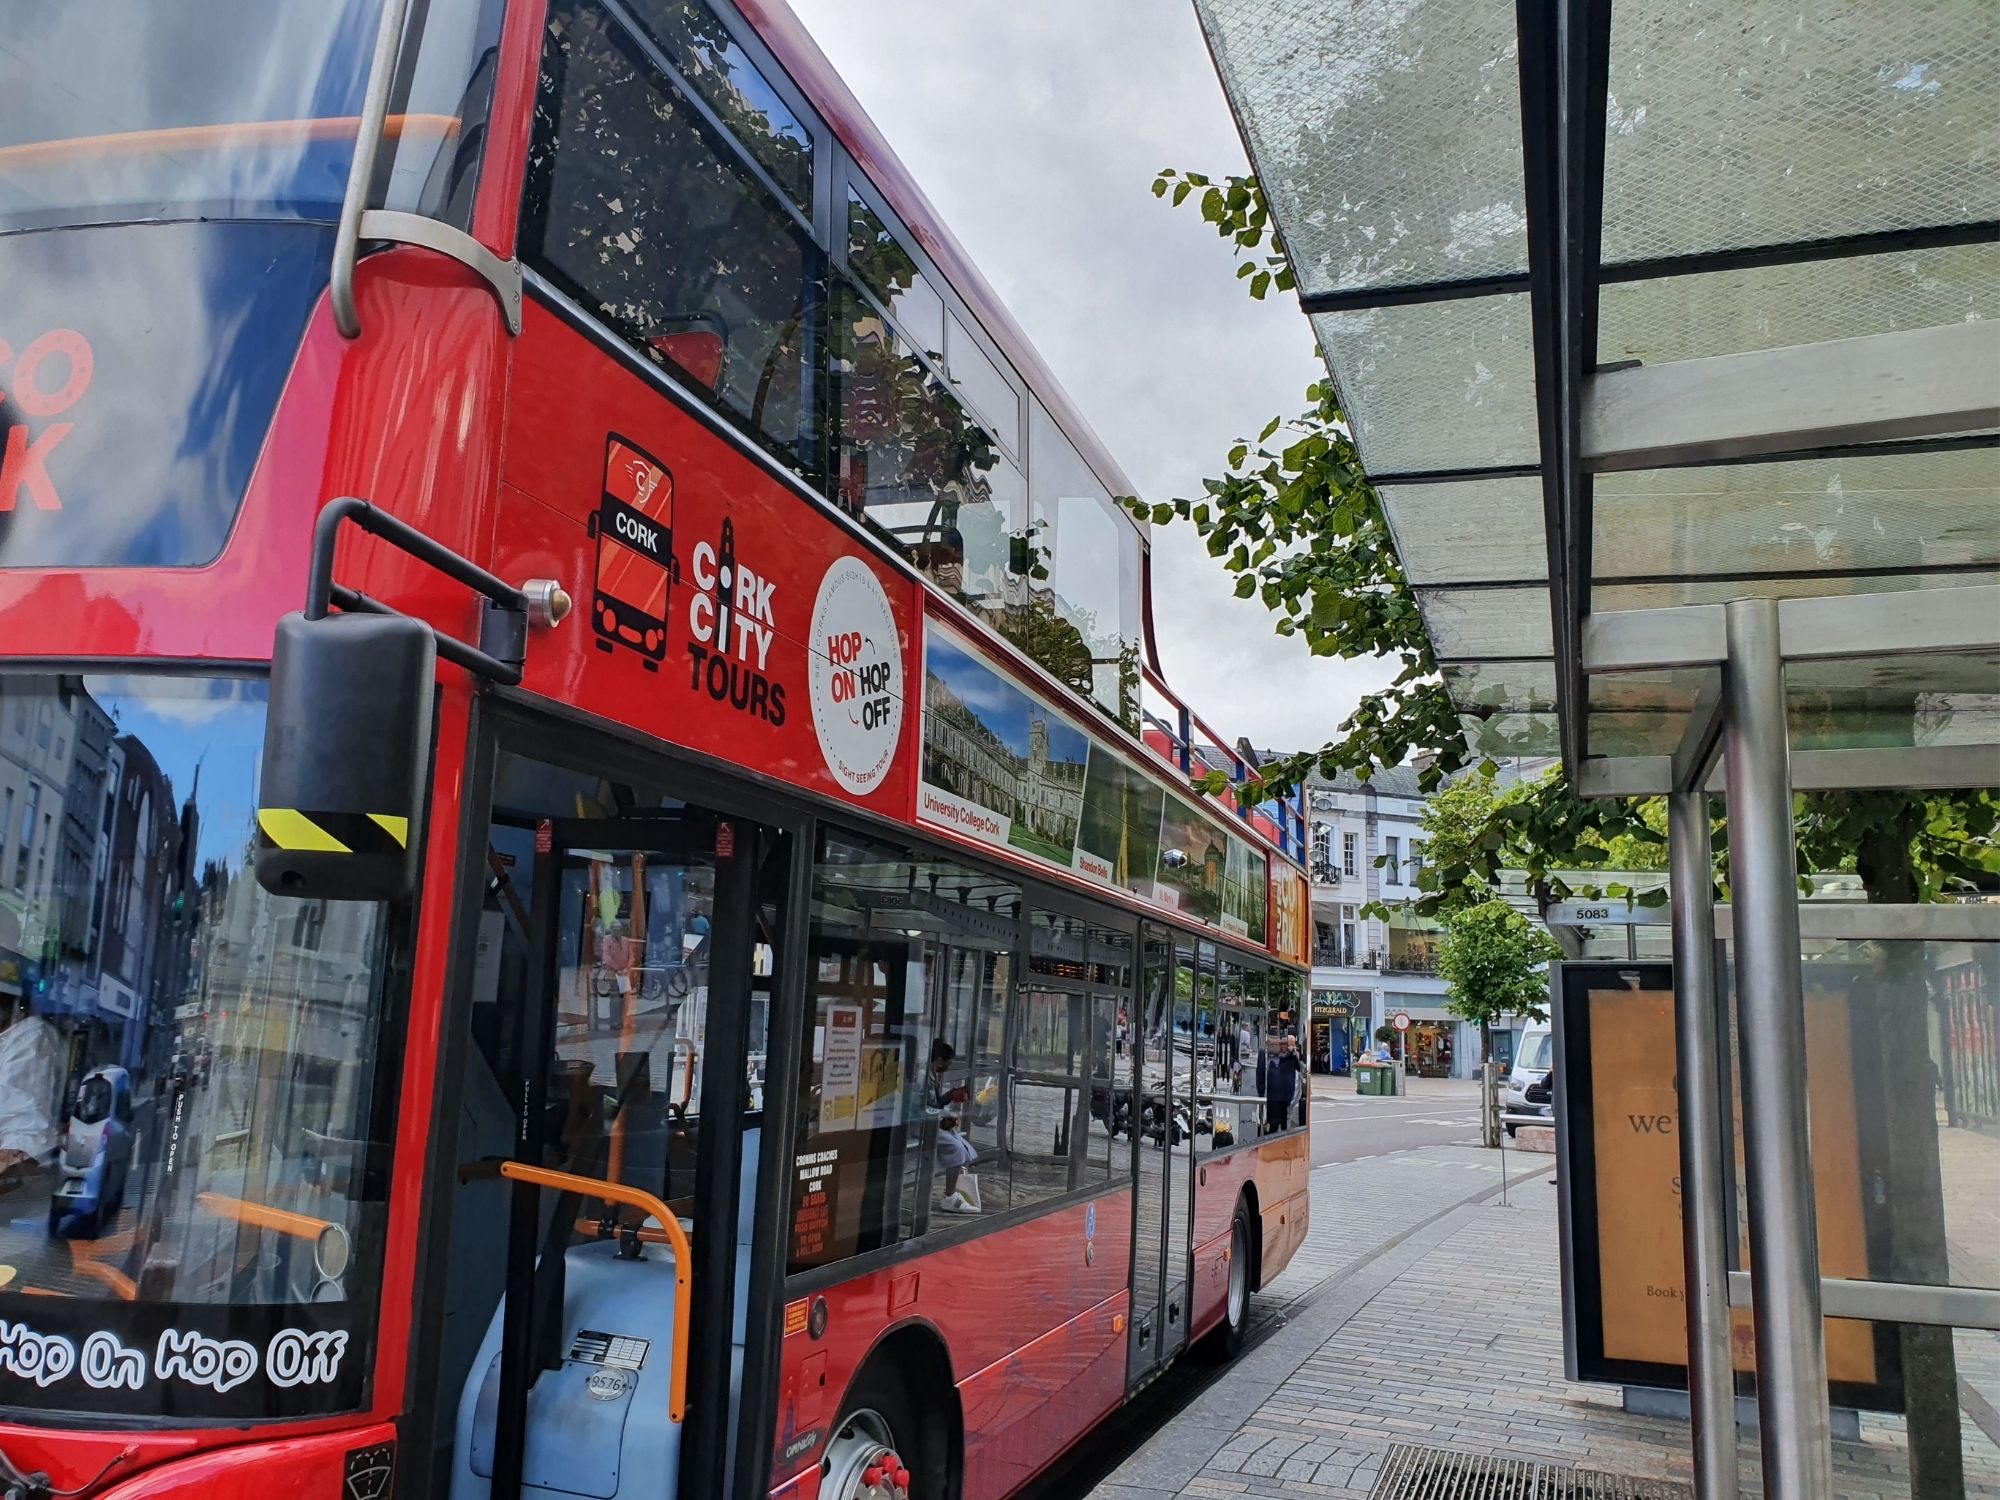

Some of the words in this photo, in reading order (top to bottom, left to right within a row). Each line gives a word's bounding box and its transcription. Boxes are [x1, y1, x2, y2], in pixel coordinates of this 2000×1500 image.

[0, 328, 94, 417] O
[615, 512, 658, 553] CORK
[690, 592, 774, 671] CITY
[828, 631, 862, 667] HOP
[687, 642, 786, 727] TOURS
[831, 669, 856, 703] ON
[860, 661, 891, 696] HOP
[863, 696, 891, 731] OFF
[838, 760, 855, 782] SIGHT
[856, 769, 876, 784] SEEING
[875, 749, 889, 772] TOUR
[924, 791, 960, 823] University
[960, 807, 984, 832] College
[985, 817, 1000, 836] Cork
[1576, 909, 1609, 919] 5083
[1314, 1006, 1347, 1014] FITZGERALD
[175, 1094, 184, 1122] PUSH
[1627, 1109, 1678, 1134] we
[172, 1125, 179, 1140] TO
[167, 1143, 176, 1172] OPEN
[817, 1149, 838, 1163] COACHES
[1647, 1285, 1677, 1298] Book
[81, 1330, 145, 1390] On
[155, 1328, 258, 1393] Hop
[266, 1328, 349, 1388] Off
[591, 1376, 621, 1391] 9576
